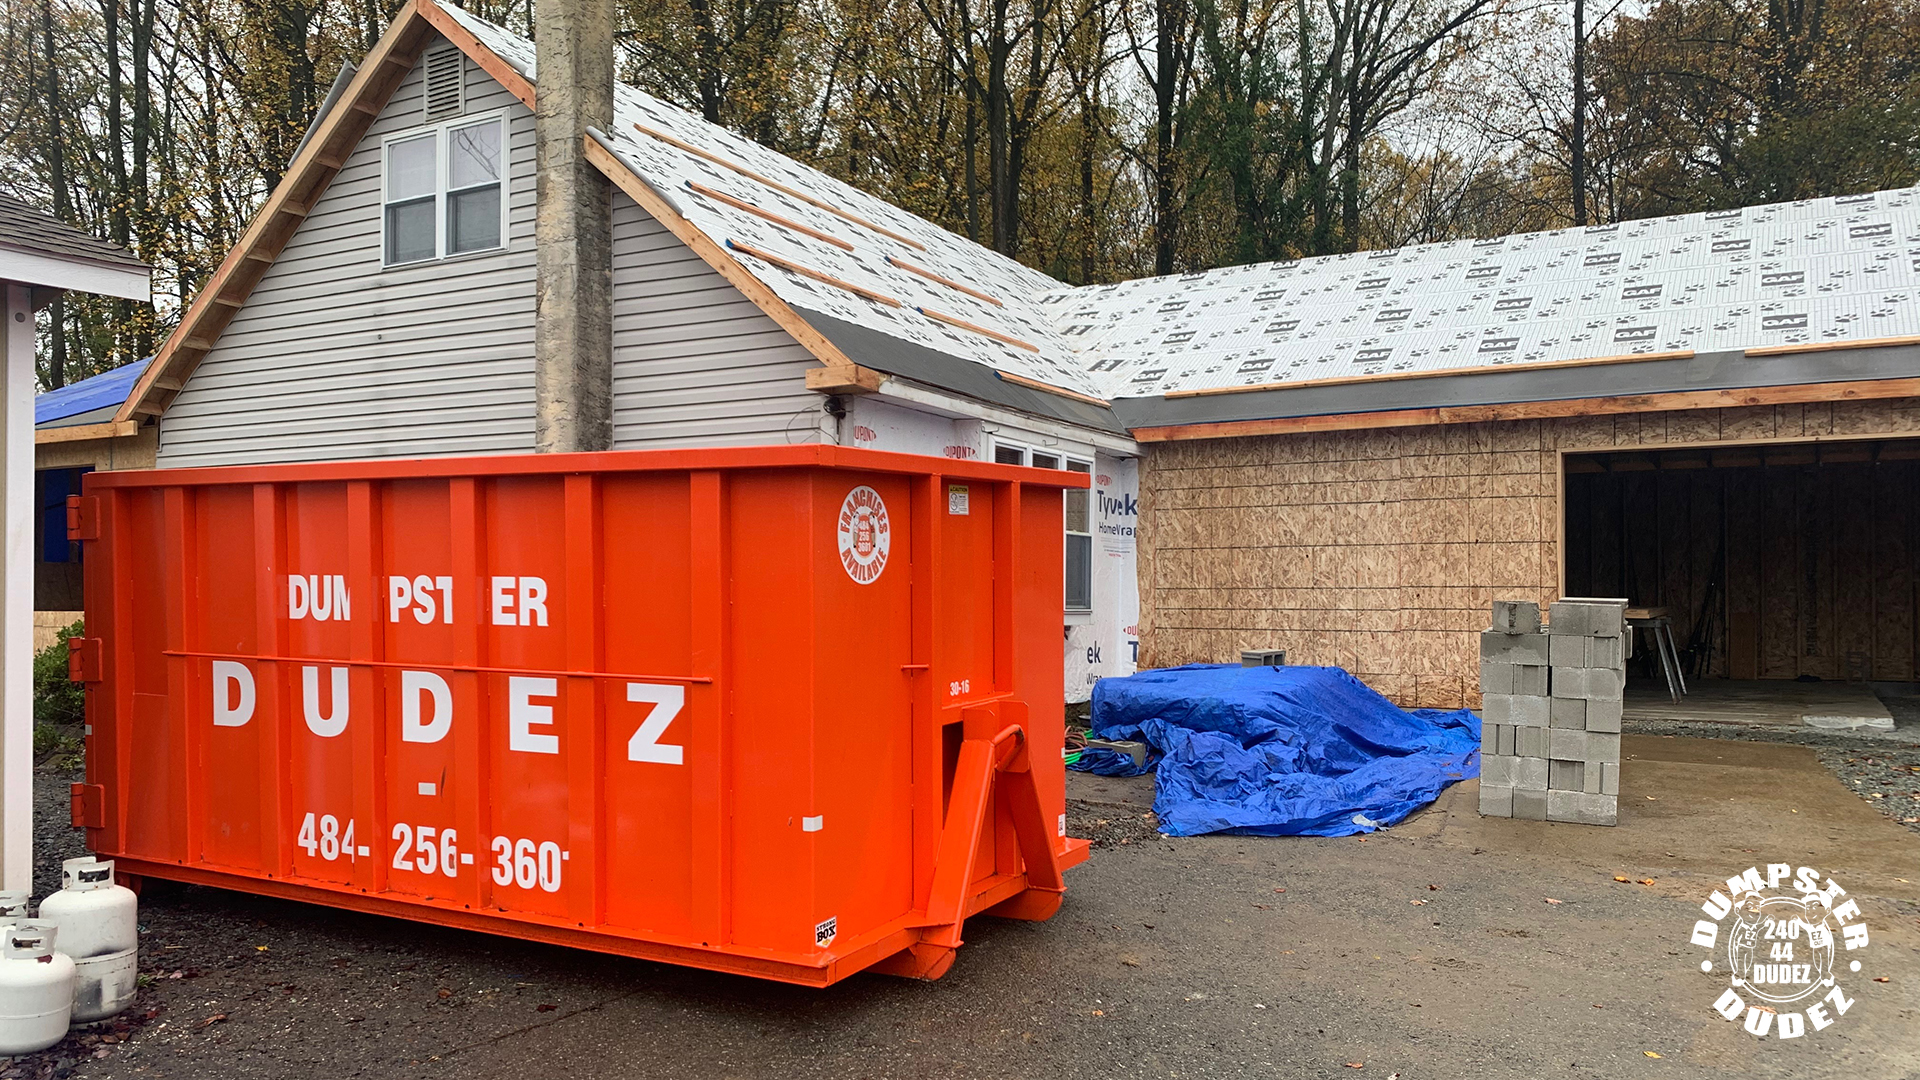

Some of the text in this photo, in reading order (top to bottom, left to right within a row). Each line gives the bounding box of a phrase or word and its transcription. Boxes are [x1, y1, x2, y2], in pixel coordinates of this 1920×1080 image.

[1849, 225, 1891, 236] GAF
[1711, 241, 1750, 251] GAF
[1584, 254, 1621, 265] GAF
[1466, 267, 1500, 278] GAF
[1358, 279, 1390, 290] GAF
[1761, 274, 1804, 285] GAF
[1622, 286, 1662, 298] GAF
[1494, 299, 1531, 310] GAF
[1376, 310, 1411, 321] GAF
[1762, 317, 1808, 327] GAF
[1615, 329, 1657, 339] GAF
[1480, 339, 1519, 350] GAF
[1354, 350, 1392, 361] GAF
[1239, 361, 1273, 371] GAF
[1097, 489, 1138, 520] Tyvek
[840, 489, 887, 534] FRANCHISES
[842, 547, 887, 581] AVAILABLE
[949, 679, 970, 696] 30-16
[491, 835, 570, 893] 360
[817, 924, 836, 943] BOX
